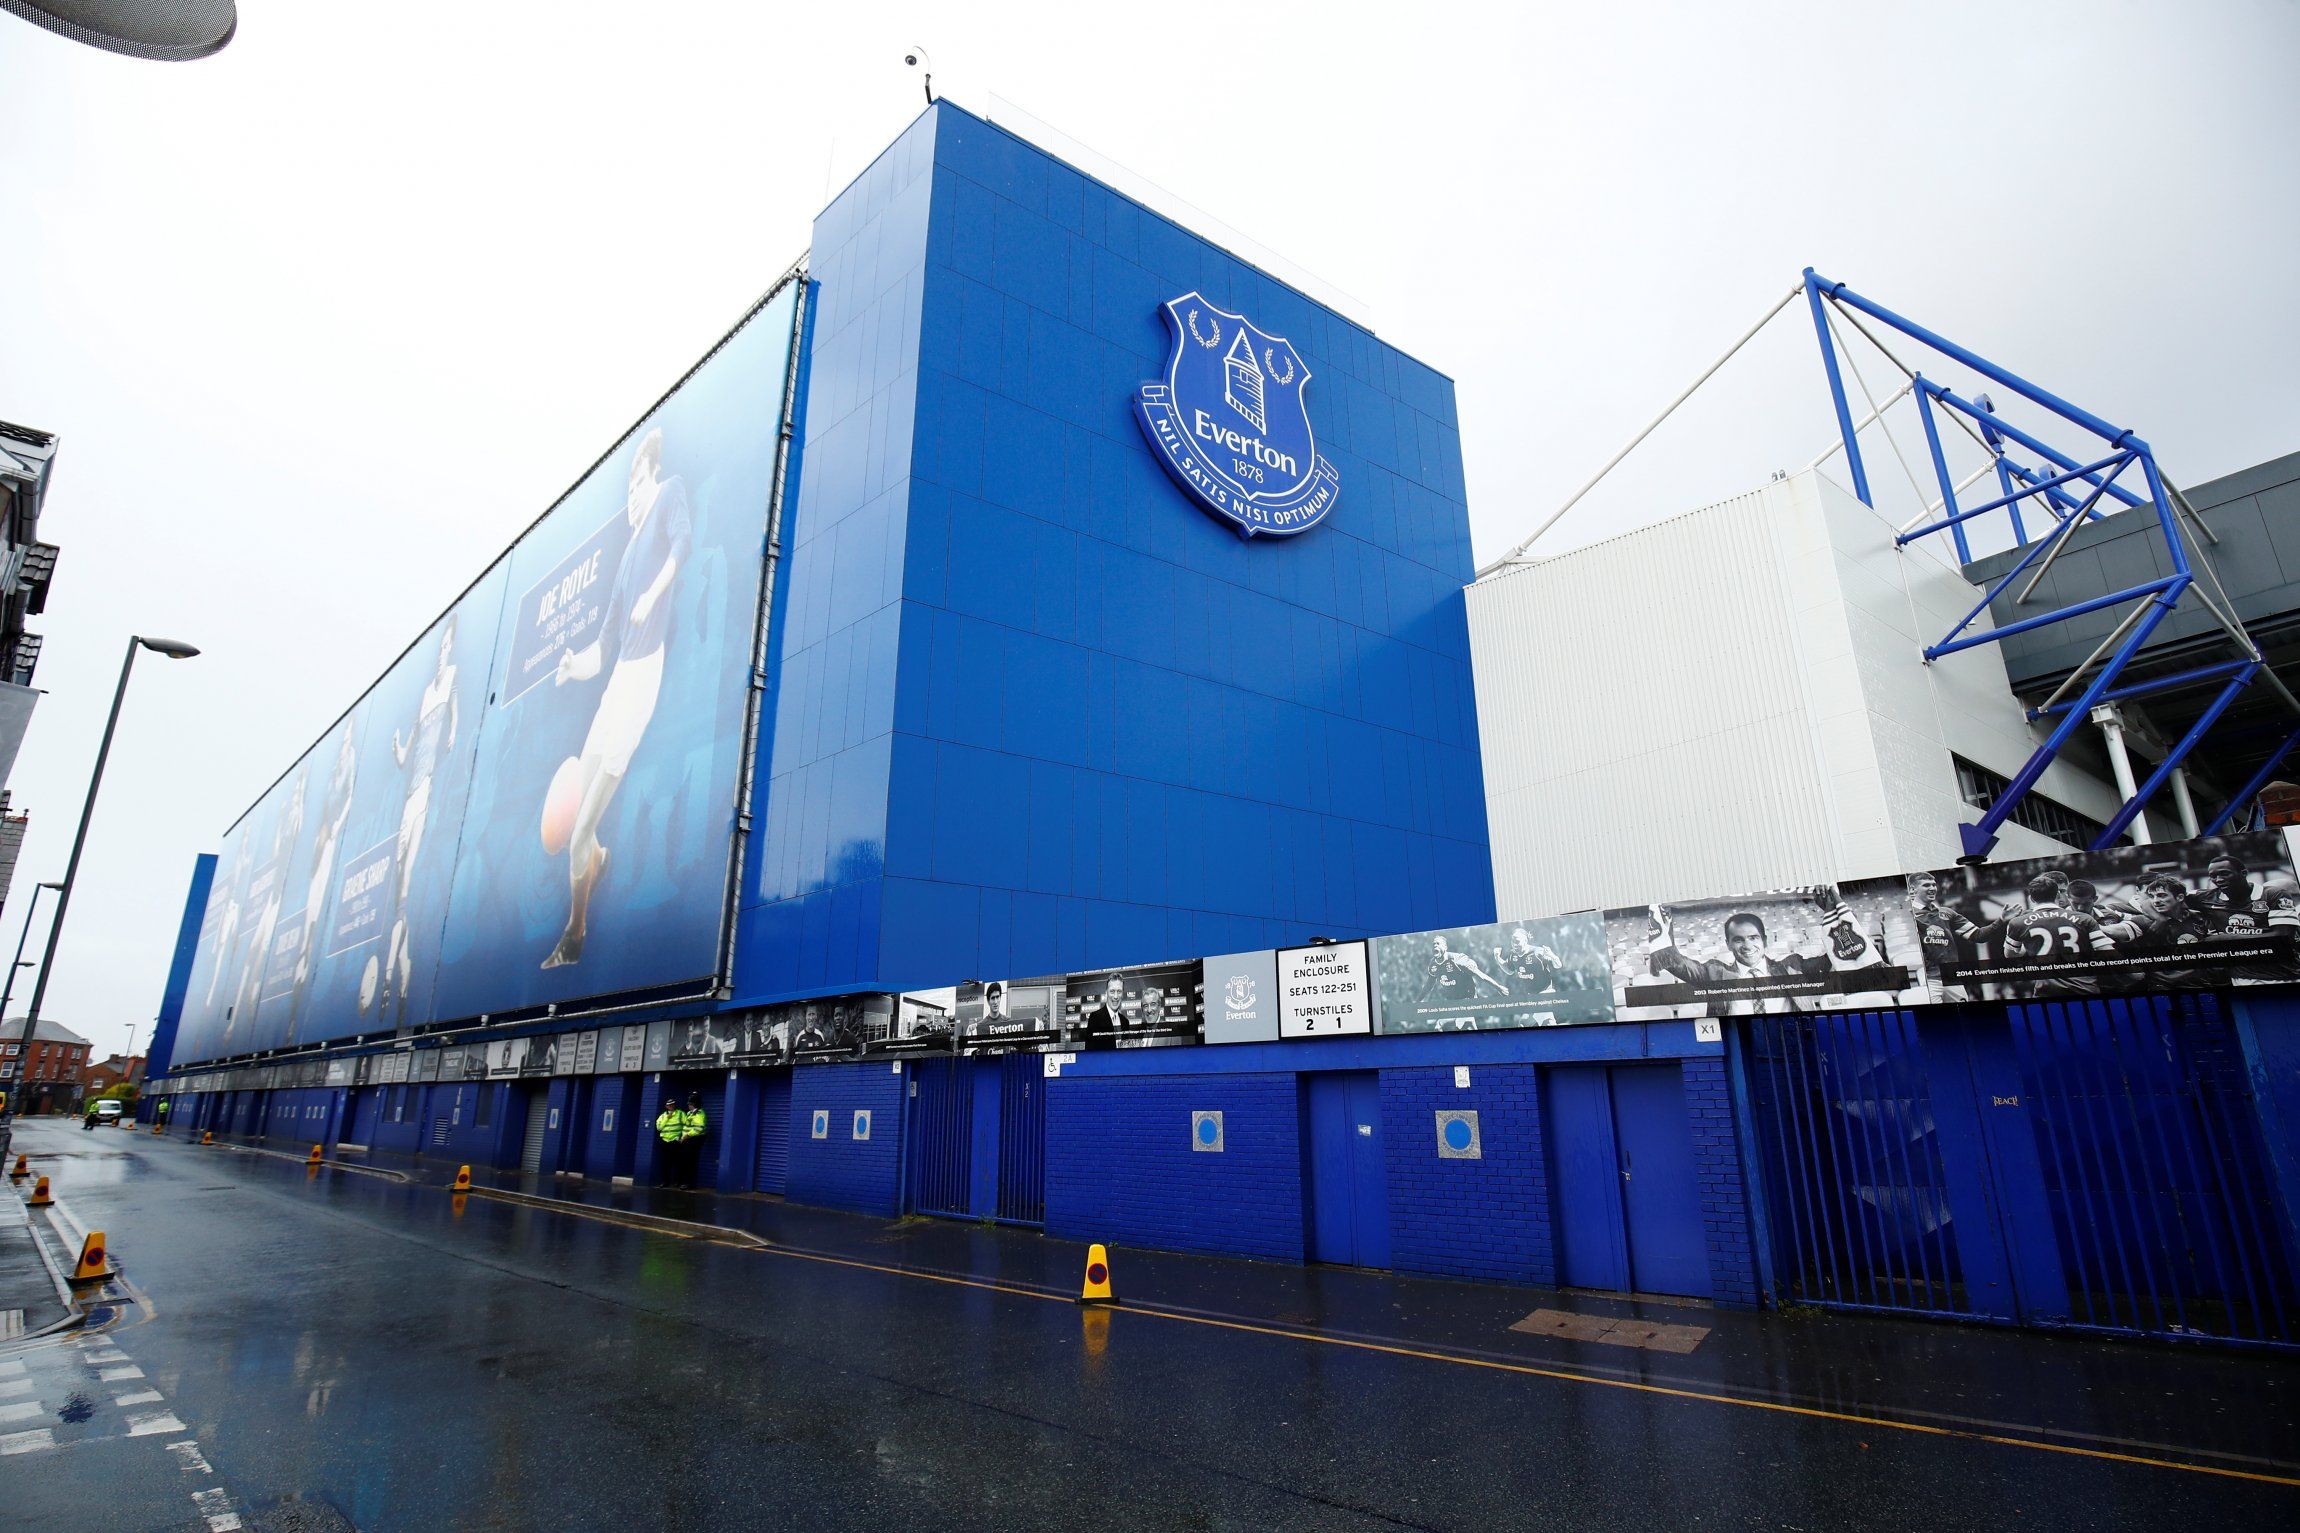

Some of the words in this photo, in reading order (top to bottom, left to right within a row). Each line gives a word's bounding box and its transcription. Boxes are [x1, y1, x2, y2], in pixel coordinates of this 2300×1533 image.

[1195, 409, 1296, 476] Everton
[1156, 418, 1180, 454] NIL
[1182, 458, 1227, 503] SATIS
[1233, 498, 1270, 524] NISI
[1274, 486, 1330, 525] OPTIMUM
[1232, 459, 1264, 484] 1878
[536, 584, 560, 626] JOE
[559, 550, 601, 608] ROYLE
[2024, 912, 2080, 926] COLEMAN
[1924, 936, 1948, 946] Chang
[2029, 926, 2080, 956] 23
[1838, 943, 1864, 957] Everton
[2230, 949, 2258, 957] League
[1304, 953, 1337, 965] FAMILY
[1294, 965, 1350, 978] ENCLOSURE
[1290, 986, 1318, 997] SEATS
[1321, 983, 1357, 994] 122-251
[1226, 1011, 1256, 1020] Everton
[1294, 1005, 1353, 1017] TURNSTILES
[989, 1023, 1024, 1035] Everton
[1306, 1019, 1314, 1030] 2
[1336, 1017, 1342, 1029] 1
[1701, 1025, 1714, 1034] X1
